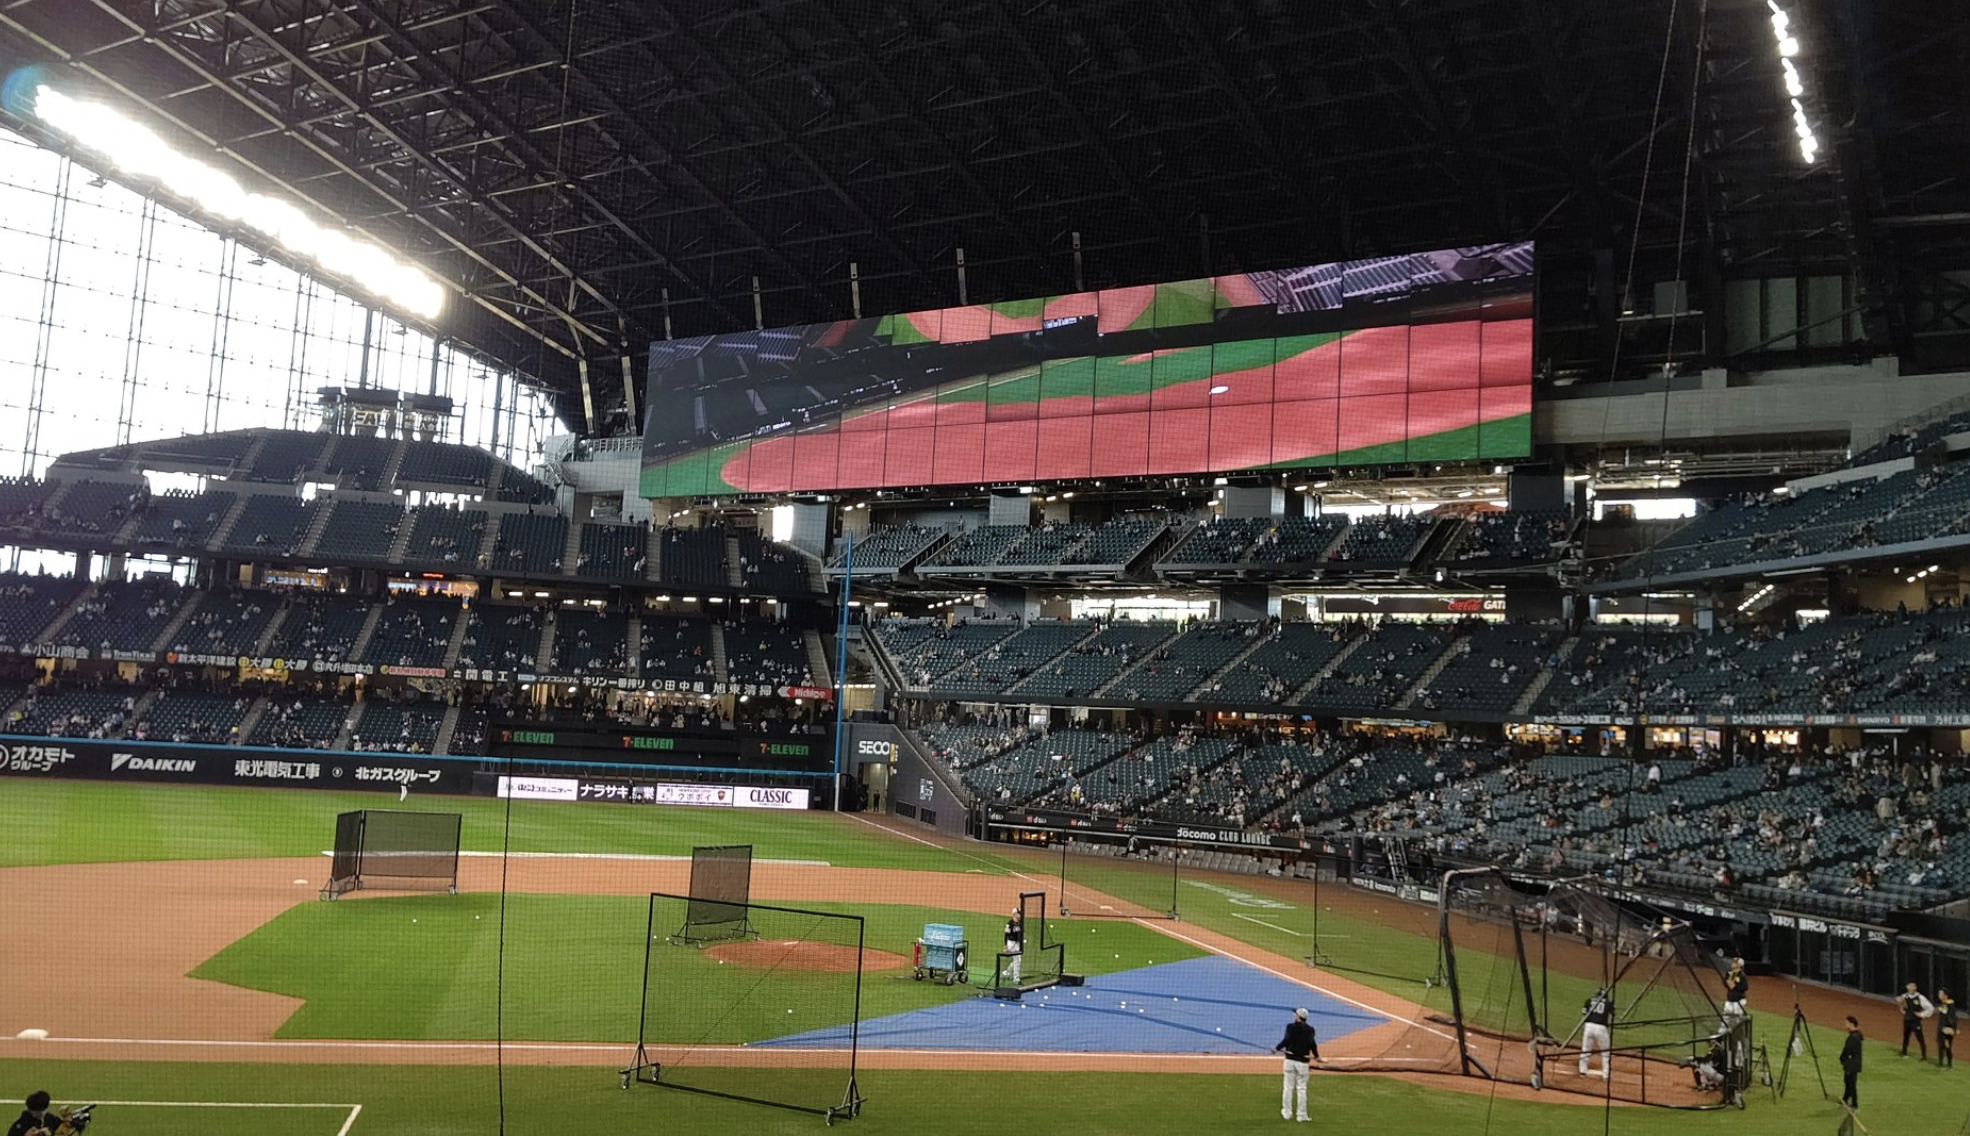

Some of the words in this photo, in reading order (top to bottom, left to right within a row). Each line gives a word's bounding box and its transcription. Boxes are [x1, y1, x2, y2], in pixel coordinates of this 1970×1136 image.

[177, 653, 237, 667] 新太平洋建設
[582, 676, 645, 689] キリン一番搾り
[664, 679, 704, 692] 田中組
[713, 682, 772, 697] 旭東清掃
[1857, 716, 1890, 724] SHINRYO
[11, 746, 76, 763] オカモト
[10, 760, 53, 772] グループ
[128, 758, 197, 772] DAIKIN
[234, 760, 321, 780] 東光電気工事
[355, 766, 441, 783] 北ガスグループ
[750, 789, 793, 804] CLASSIC
[1177, 826, 1216, 841] docomo
[1219, 830, 1239, 842] CLUB
[1242, 831, 1271, 845] LOUNGE
